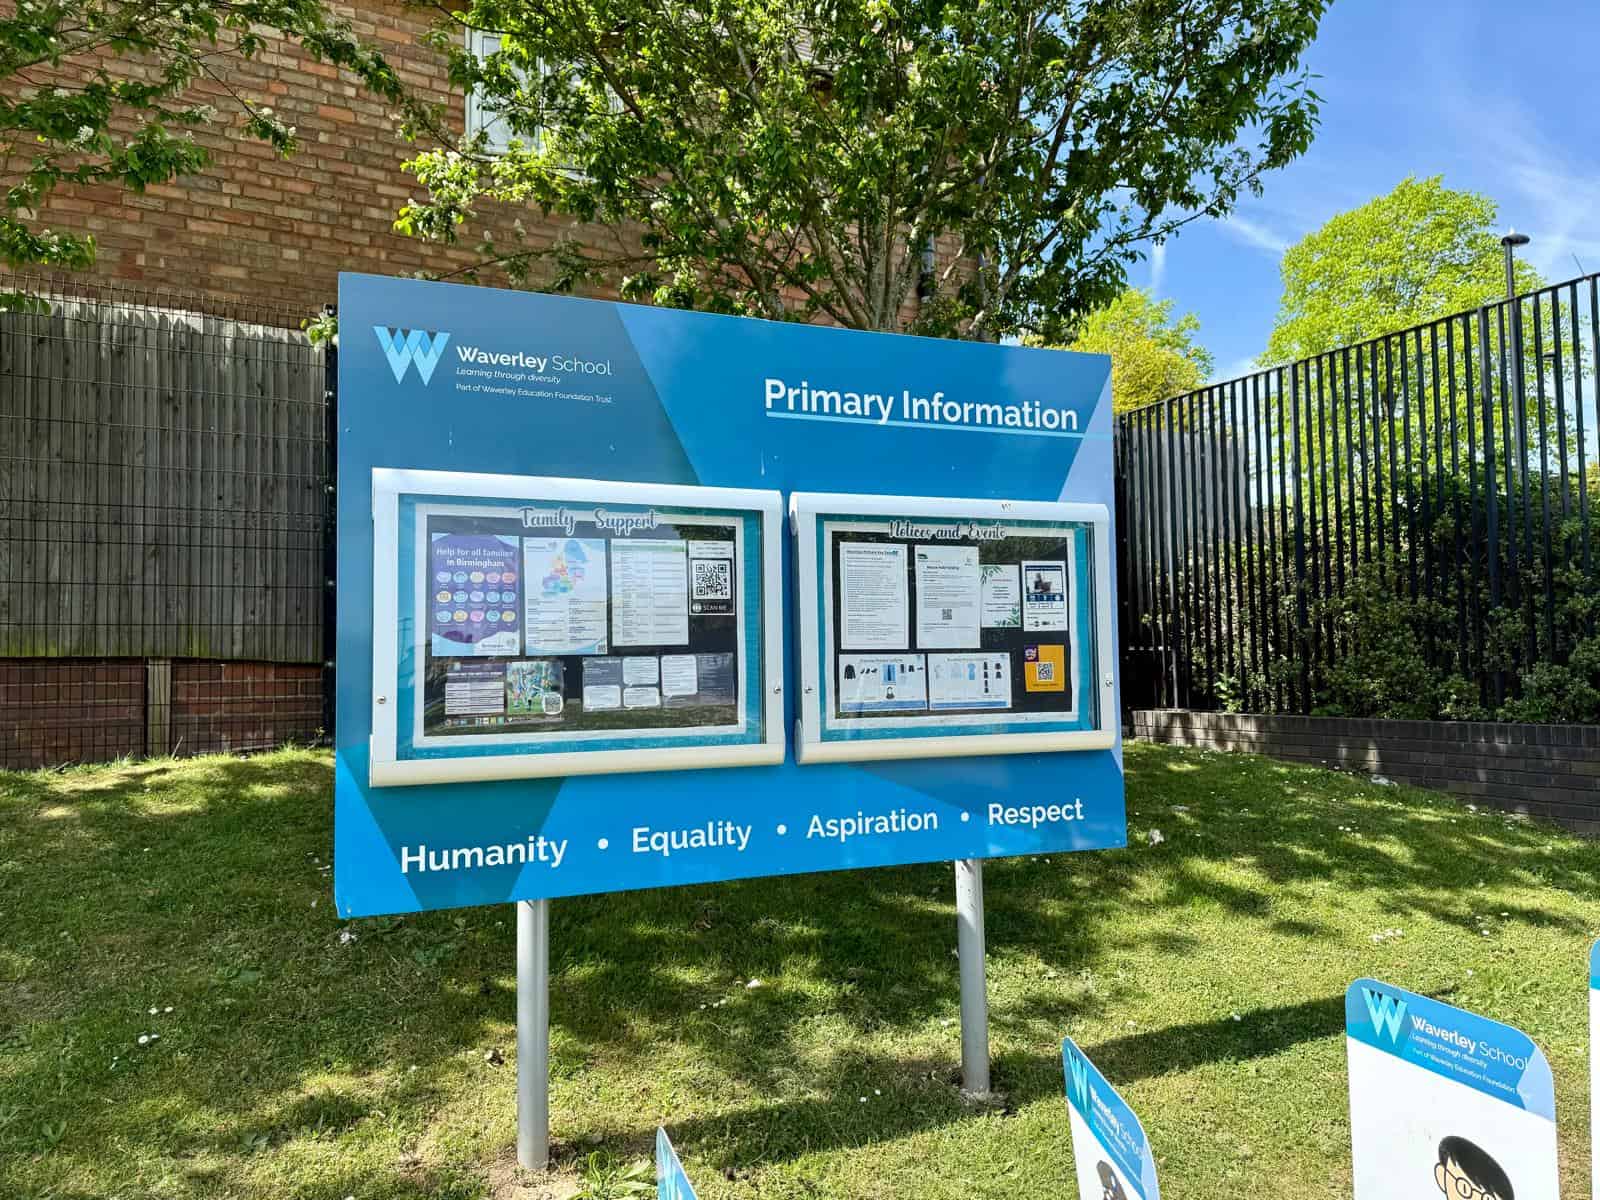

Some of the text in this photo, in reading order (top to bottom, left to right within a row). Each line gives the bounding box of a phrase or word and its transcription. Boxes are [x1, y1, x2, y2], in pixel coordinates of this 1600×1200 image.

[456, 345, 613, 376] Waverley School
[456, 367, 561, 385] Learning through diversity
[456, 383, 472, 392] Part
[474, 384, 482, 393] of
[482, 385, 517, 397] Waverley
[517, 387, 554, 399] Education
[555, 390, 594, 402] Foundation
[764, 378, 1079, 431] Primary Information
[594, 510, 660, 536] Support
[889, 519, 1008, 540] Notices and Events
[436, 547, 455, 557] Help
[457, 547, 469, 556] for
[471, 547, 481, 556] all
[447, 558, 505, 569] in Birmingham
[401, 798, 1085, 873] Humanity Equality Aspiration Respect
[1411, 1015, 1529, 1071] Waverley School
[1436, 1041, 1461, 1059] through
